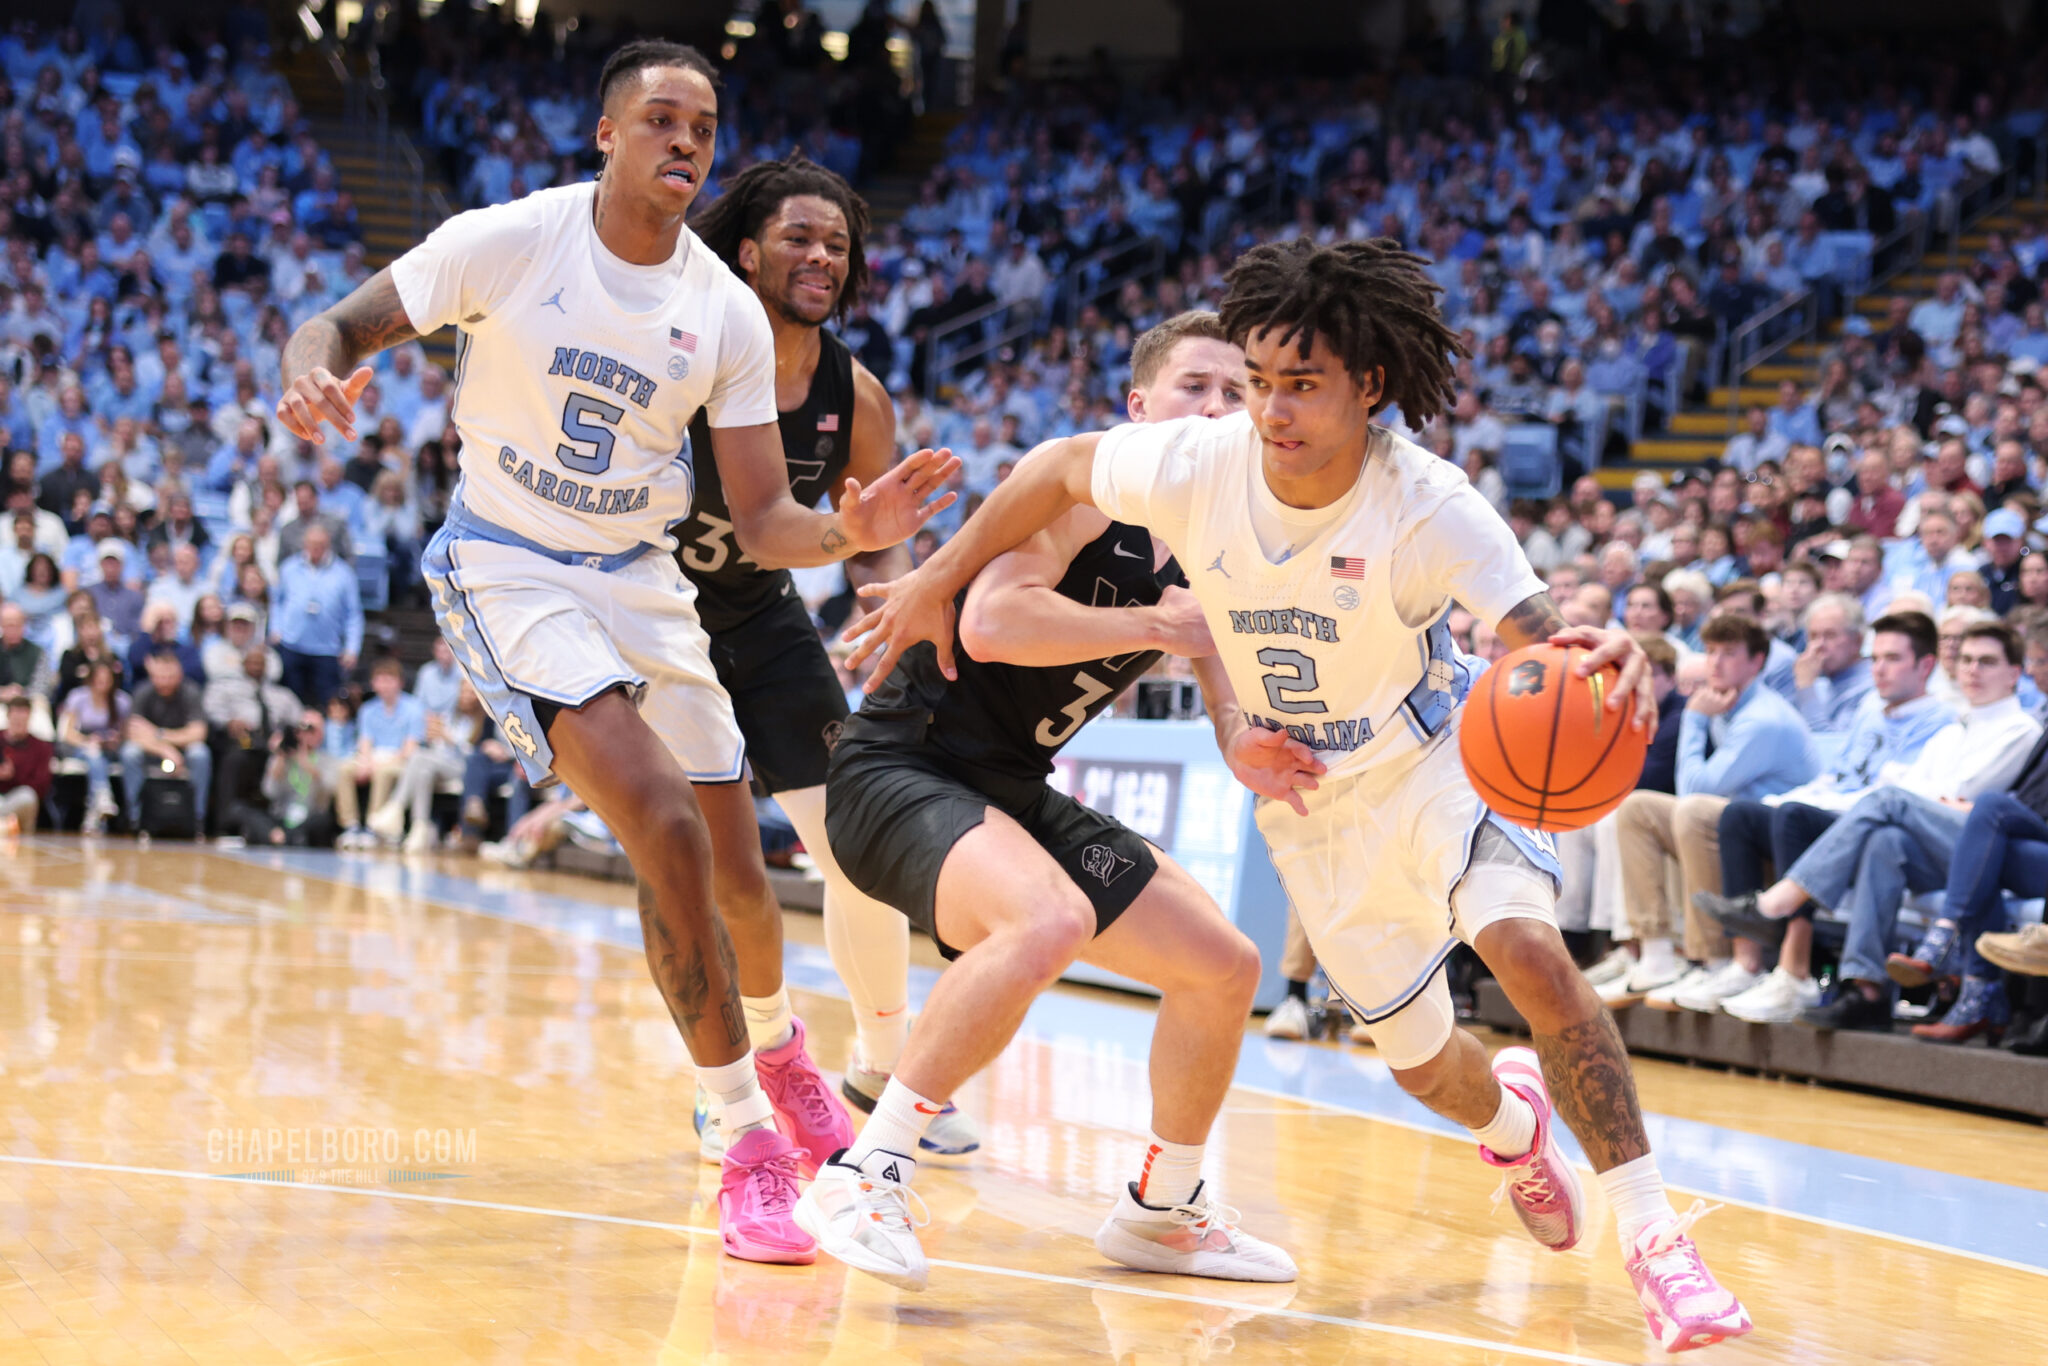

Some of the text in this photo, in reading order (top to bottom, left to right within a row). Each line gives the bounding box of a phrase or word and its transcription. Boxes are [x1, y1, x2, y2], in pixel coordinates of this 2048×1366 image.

[548, 347, 657, 409] NORTH
[556, 391, 625, 475] 5
[499, 446, 649, 514] CAROLINA
[1228, 607, 1340, 643] NORTH
[1035, 670, 1114, 747] 3
[1256, 647, 1329, 714] 2
